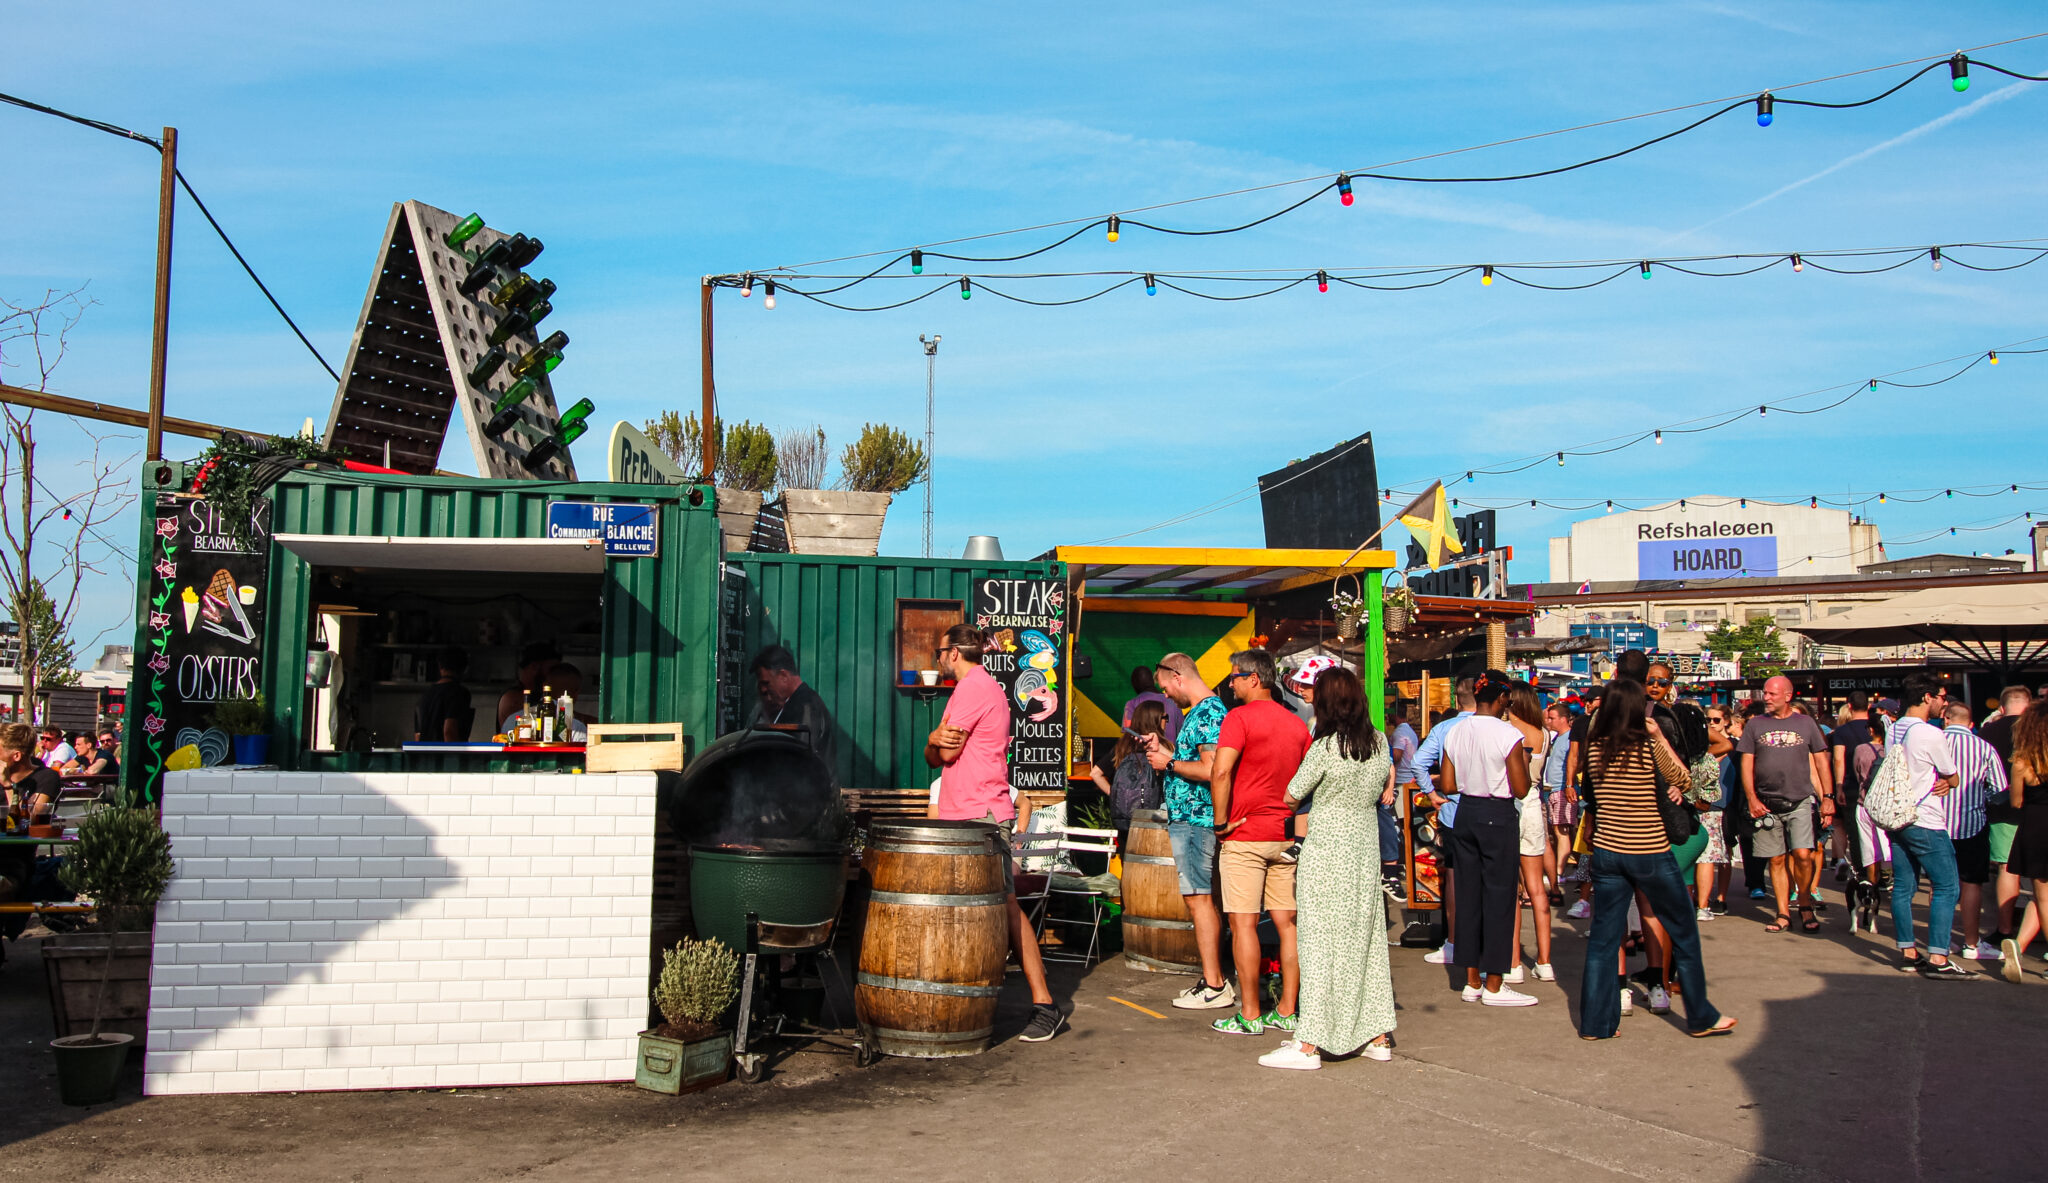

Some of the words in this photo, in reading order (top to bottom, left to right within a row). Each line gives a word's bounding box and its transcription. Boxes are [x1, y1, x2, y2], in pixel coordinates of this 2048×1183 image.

[188, 499, 266, 537] STEK
[592, 507, 615, 522] RUE
[1638, 521, 1774, 540] Refshaleøen
[194, 535, 259, 552] BEARNA
[613, 543, 651, 551] BELLEVUE
[1673, 547, 1743, 571] HOARD
[983, 579, 1058, 616] STEAK
[992, 614, 1049, 628] BEARNAISE
[982, 654, 1015, 672] RUITS
[178, 654, 259, 700] OYSTERS
[1829, 679, 1856, 689] BEER
[1864, 678, 1892, 688] WINE
[1015, 718, 1063, 738] MOULES
[1015, 741, 1062, 762] FRITES
[1013, 766, 1063, 787] FRANCAISE
